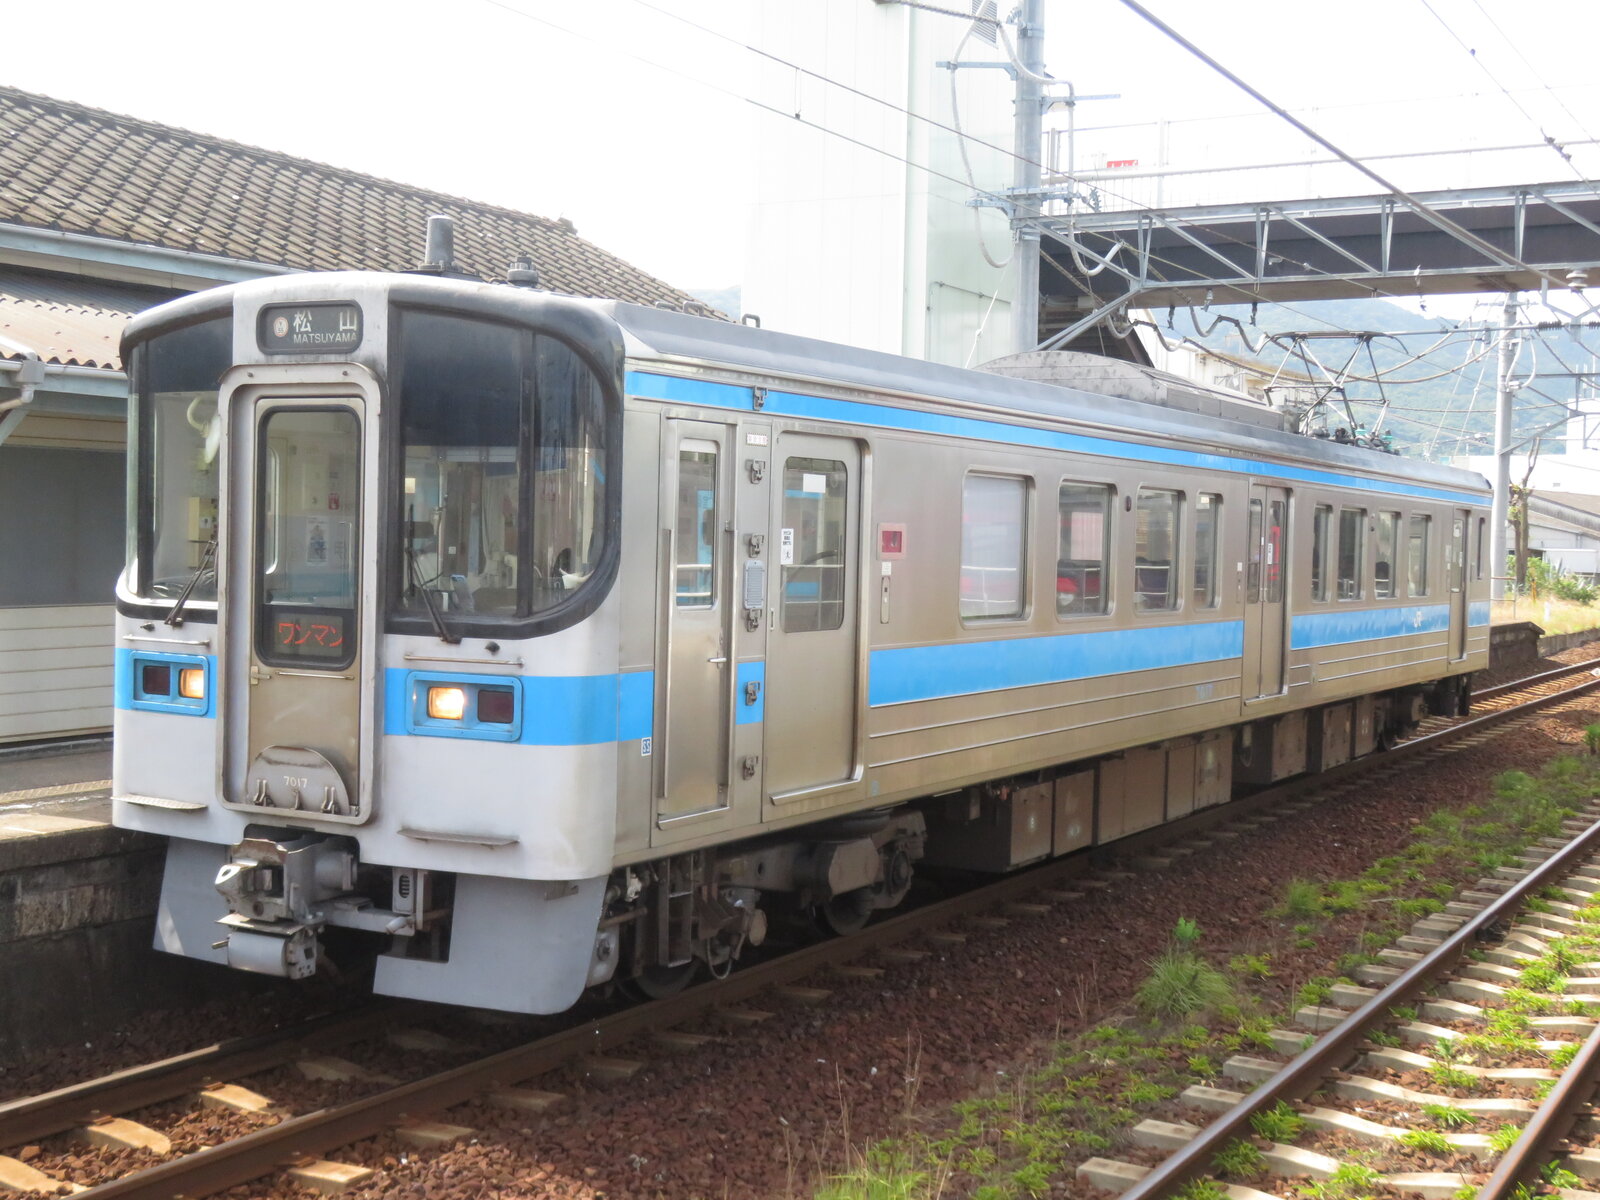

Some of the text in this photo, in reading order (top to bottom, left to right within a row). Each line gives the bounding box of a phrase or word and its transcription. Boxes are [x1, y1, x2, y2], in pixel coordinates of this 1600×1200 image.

[293, 332, 357, 344] MATSUYAMA
[278, 622, 344, 647] ワンマン
[283, 775, 308, 788] 7017
